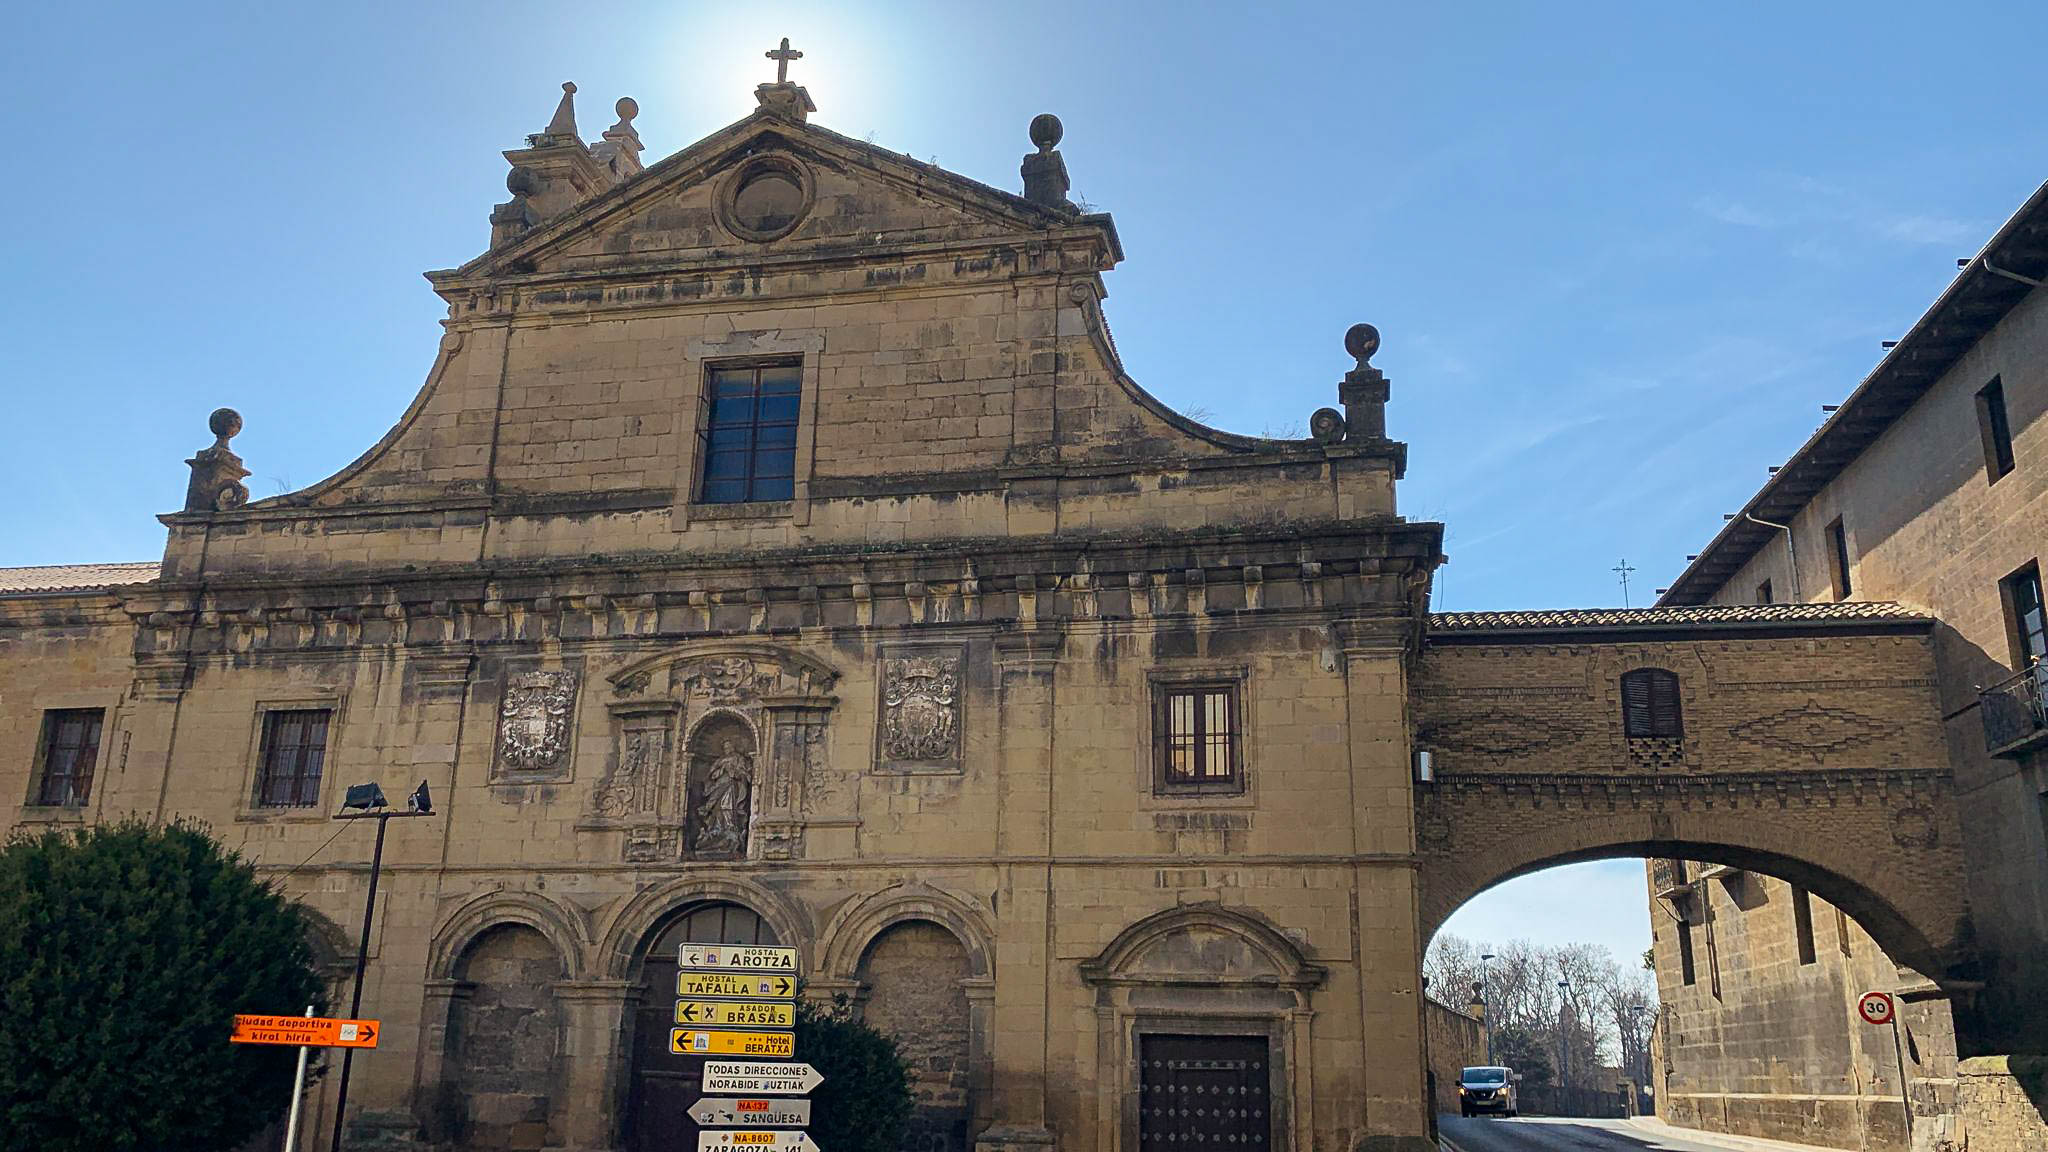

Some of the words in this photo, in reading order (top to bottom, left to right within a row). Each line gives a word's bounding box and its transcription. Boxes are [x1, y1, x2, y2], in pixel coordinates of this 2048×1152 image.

[730, 953, 792, 968] AROTZA
[701, 975, 737, 983] HOSTAL
[687, 982, 750, 994] TAFALLA
[739, 1005, 776, 1013] ASADOR
[1867, 1002, 1885, 1013] 30
[727, 1012, 786, 1024] BRASAS
[278, 1019, 332, 1029] deportiva
[251, 1031, 279, 1041] kirol
[766, 1036, 790, 1045] Hotel
[745, 1044, 790, 1054] BERATXA
[707, 1064, 741, 1075] TODAS
[744, 1065, 808, 1076] DIRECCIONES
[709, 1079, 759, 1090] NORABIDE
[762, 1080, 804, 1090] UZTIAK
[743, 1111, 803, 1123] SANGÜESA
[734, 1134, 774, 1143] NA-8607
